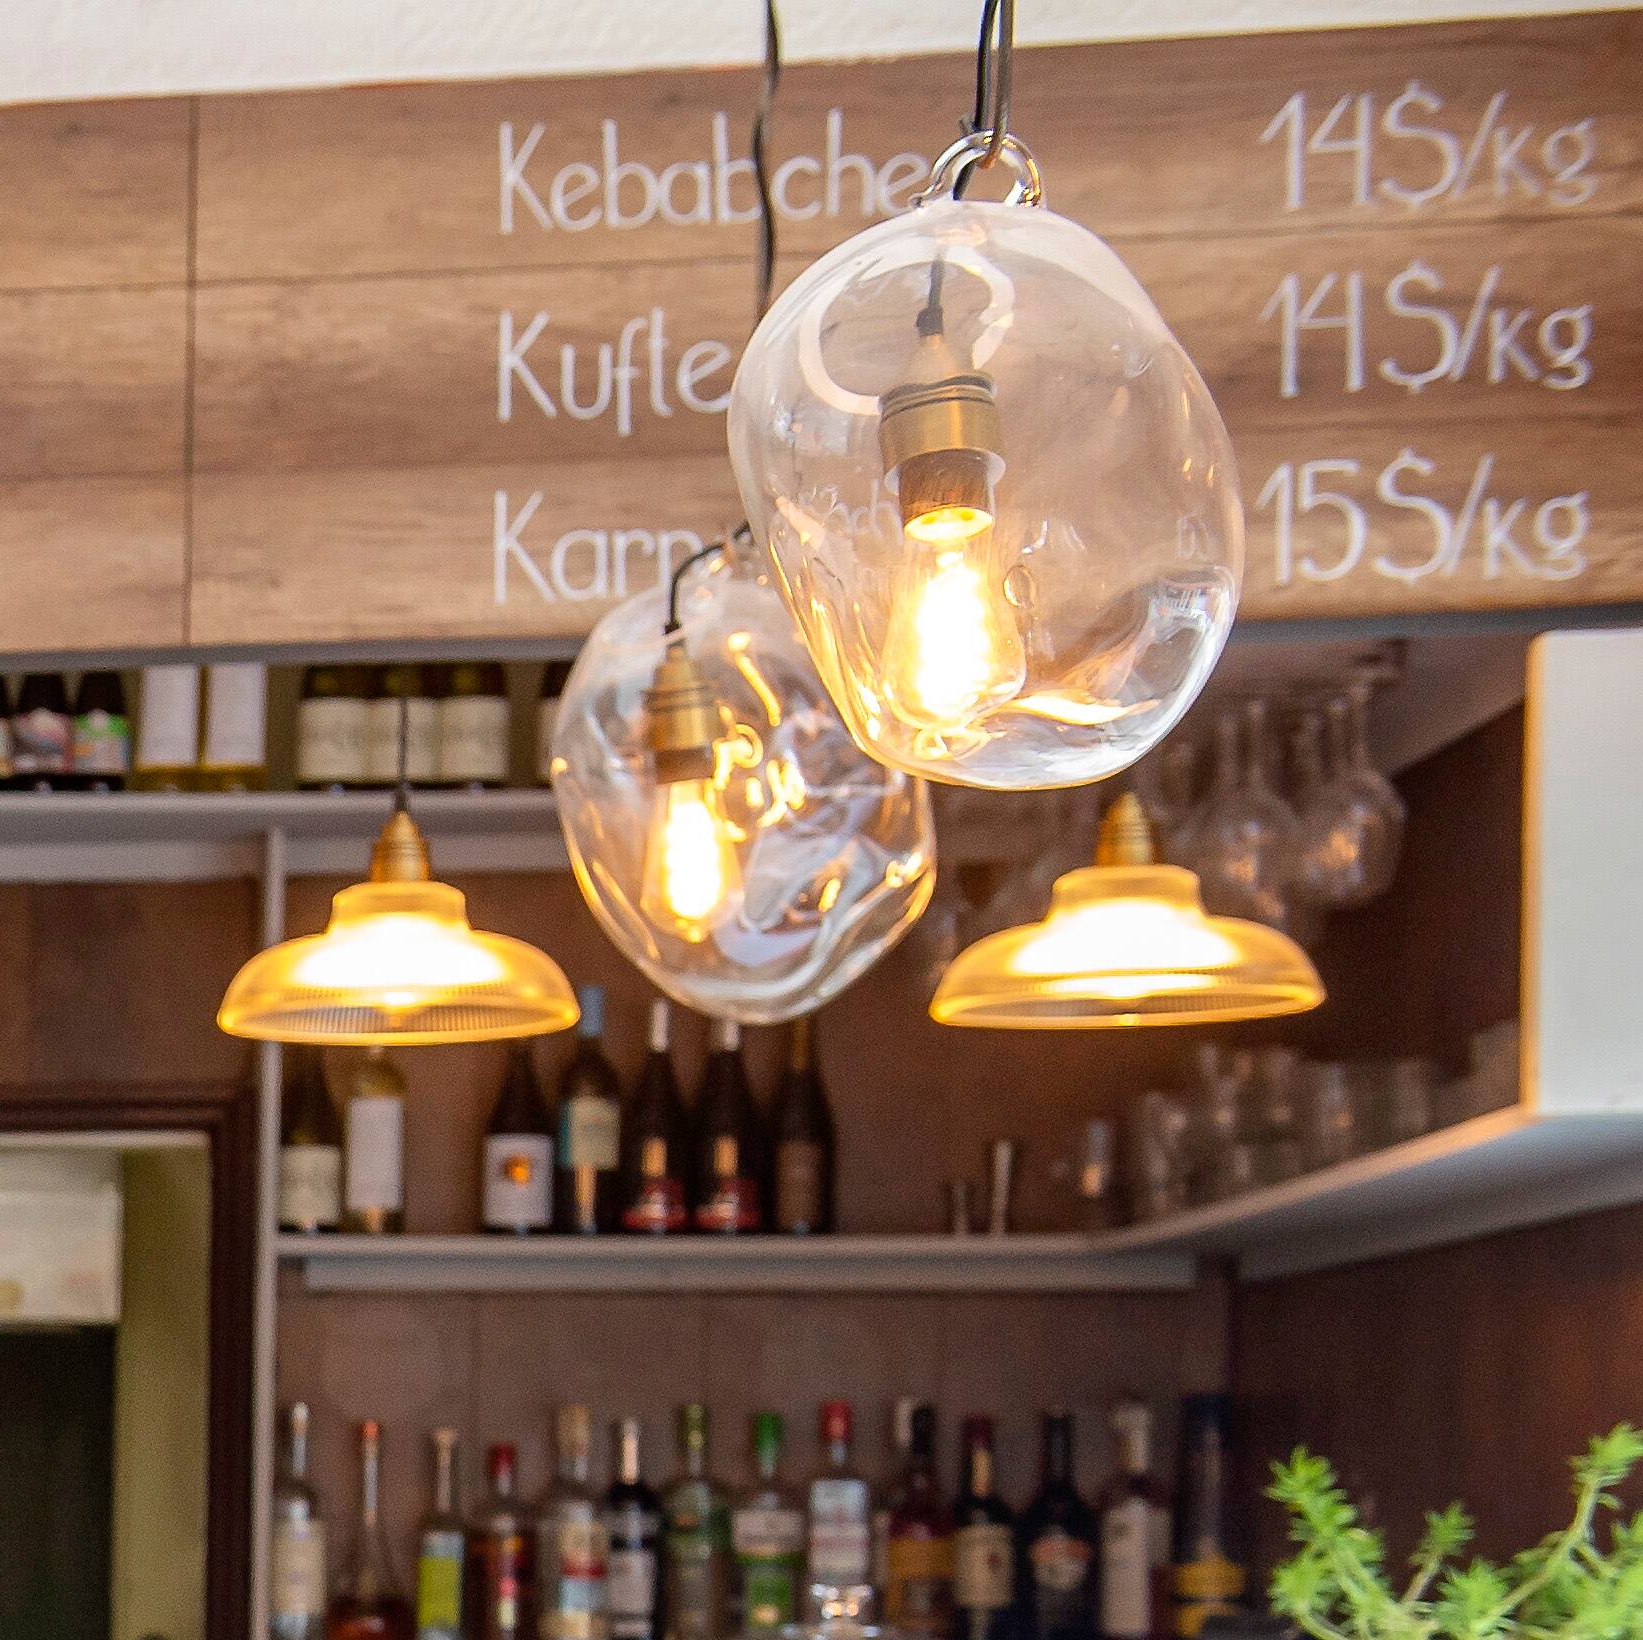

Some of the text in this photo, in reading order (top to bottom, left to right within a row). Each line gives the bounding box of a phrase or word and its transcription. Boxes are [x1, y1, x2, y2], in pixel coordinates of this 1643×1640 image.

[1259, 79, 1600, 211] 14$/kg
[1258, 258, 1595, 397] 14$/kg
[1255, 447, 1591, 586] 15$/kg
